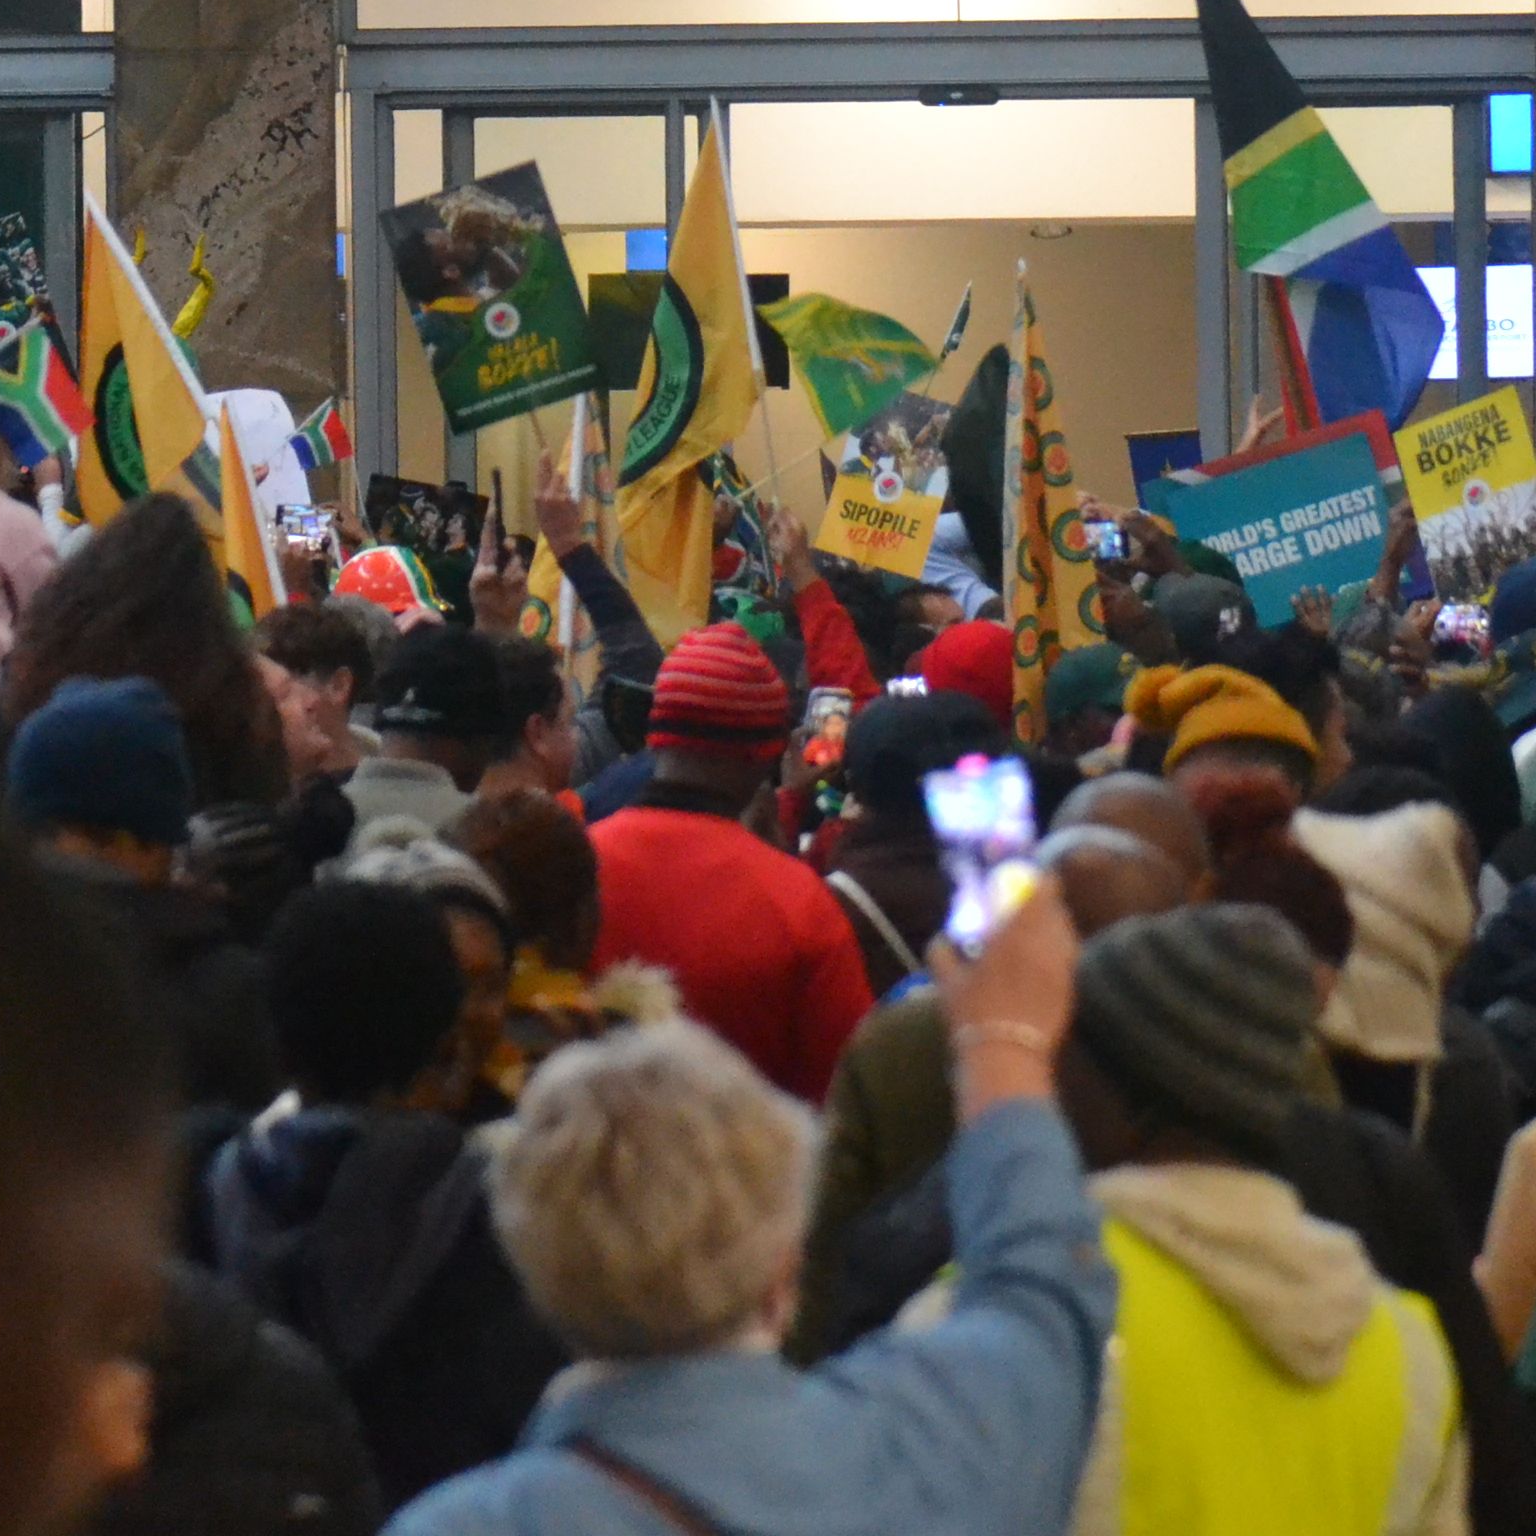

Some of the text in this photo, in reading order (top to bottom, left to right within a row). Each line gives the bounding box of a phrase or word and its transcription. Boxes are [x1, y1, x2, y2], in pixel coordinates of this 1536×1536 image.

[630, 373, 681, 449] LEAGUE
[1416, 420, 1513, 476] BOKKE
[840, 499, 921, 540] SIPOPILE
[1279, 485, 1378, 534] GREATEST
[1232, 510, 1382, 579] ARGE DOWN
